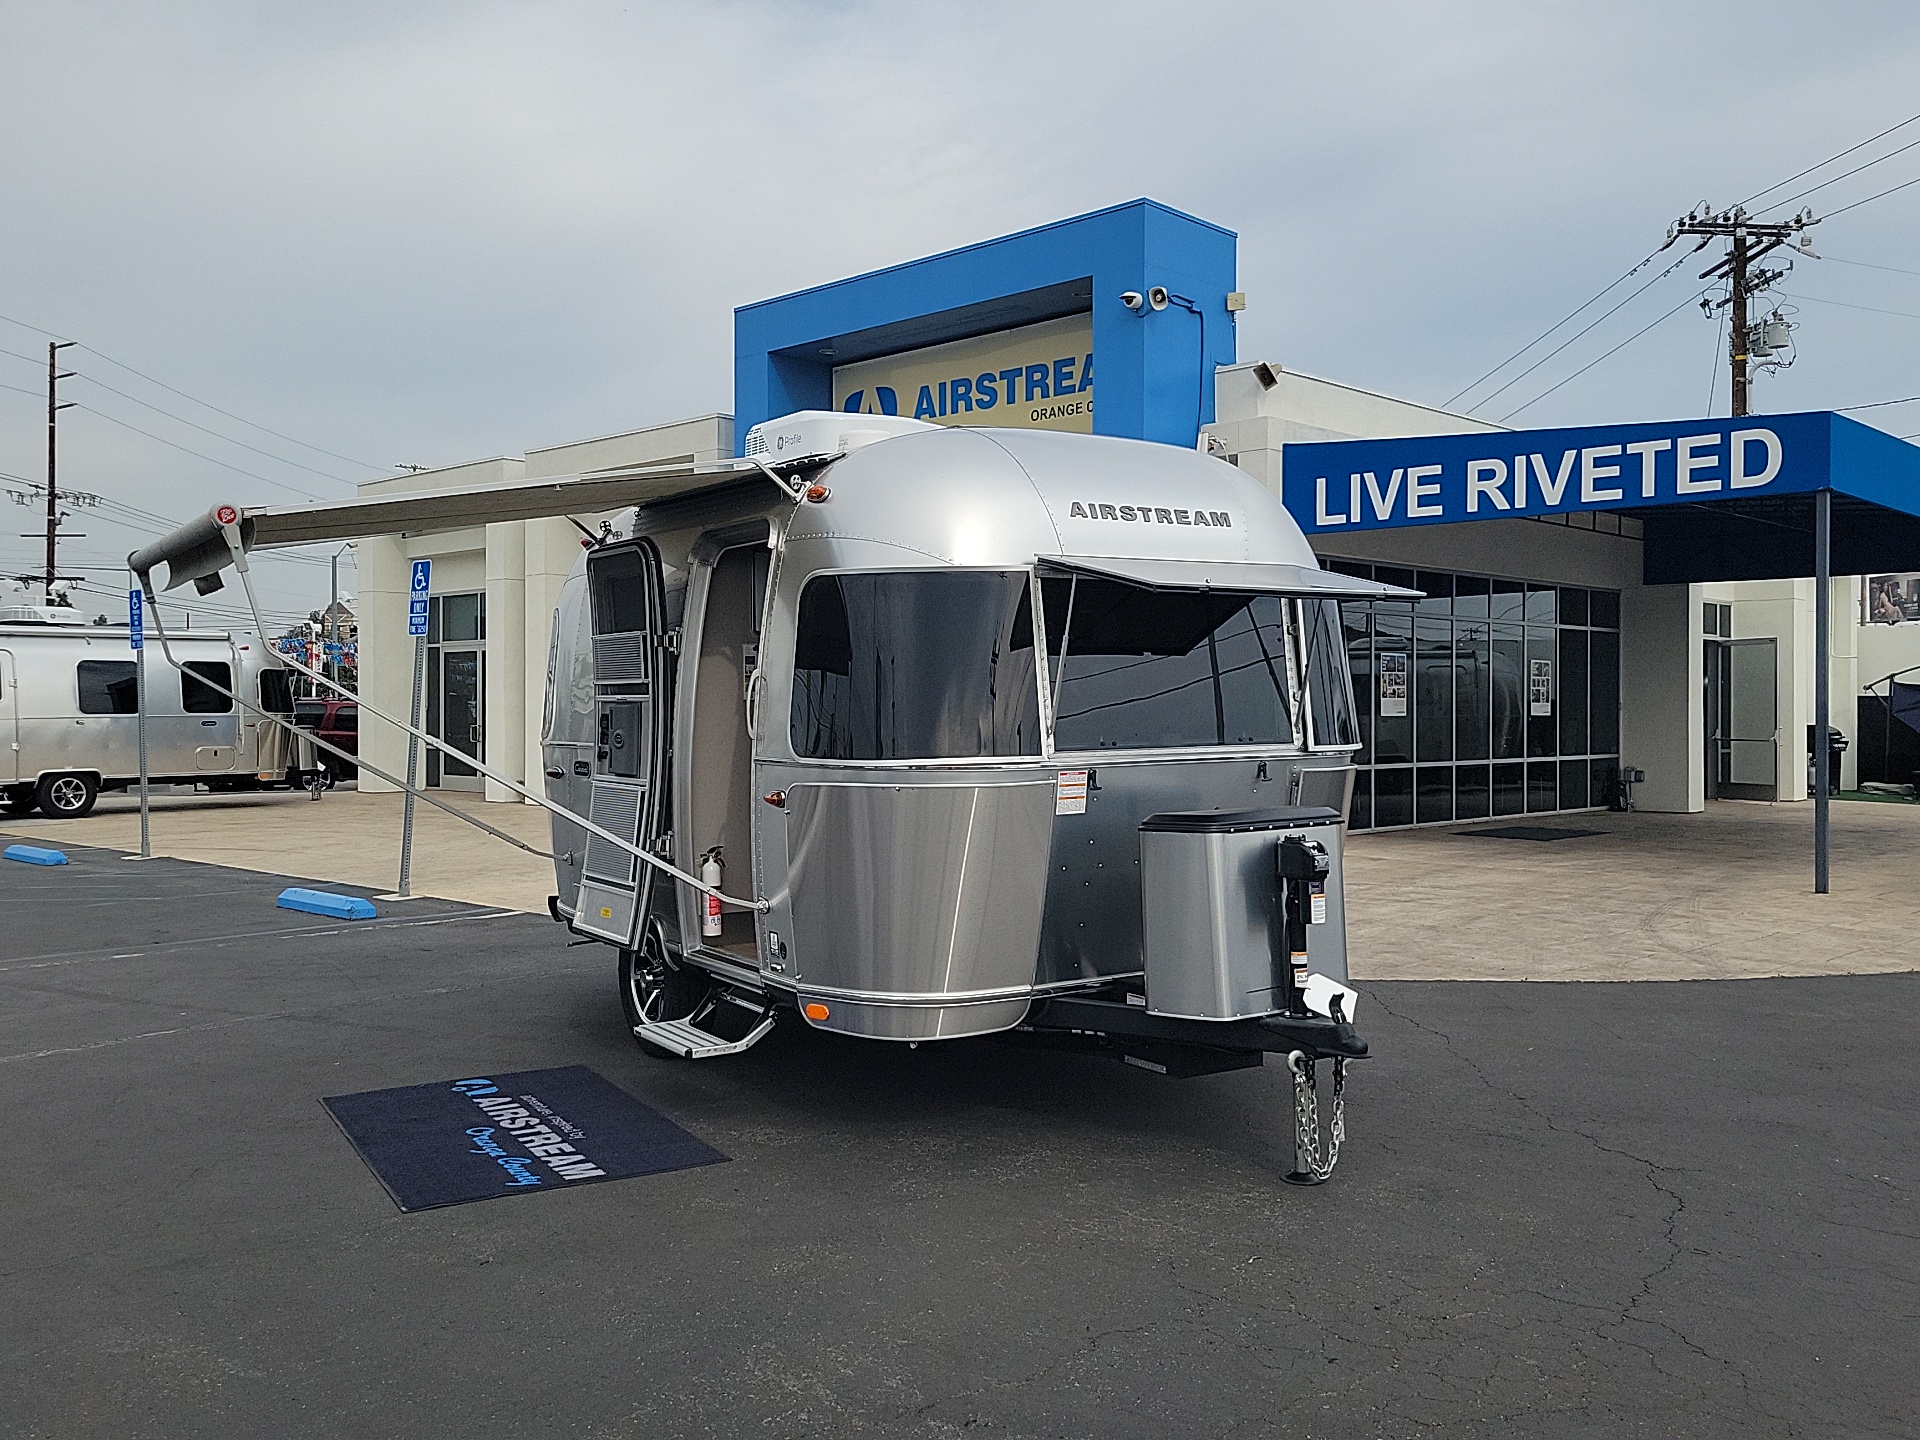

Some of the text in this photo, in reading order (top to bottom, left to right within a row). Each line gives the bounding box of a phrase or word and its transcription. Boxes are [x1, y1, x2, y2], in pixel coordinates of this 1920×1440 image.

[914, 353, 1093, 420] AIRSTREA
[1030, 401, 1083, 421] ORANGE
[784, 434, 802, 447] Profile
[1315, 428, 1784, 526] LIVE RIVETED
[1070, 501, 1232, 527] AIRSTREAM
[411, 590, 429, 602] PARKING
[413, 602, 425, 613] ONLY
[472, 1097, 607, 1180] AIRSTREAM
[466, 1126, 542, 1186] Orange County
